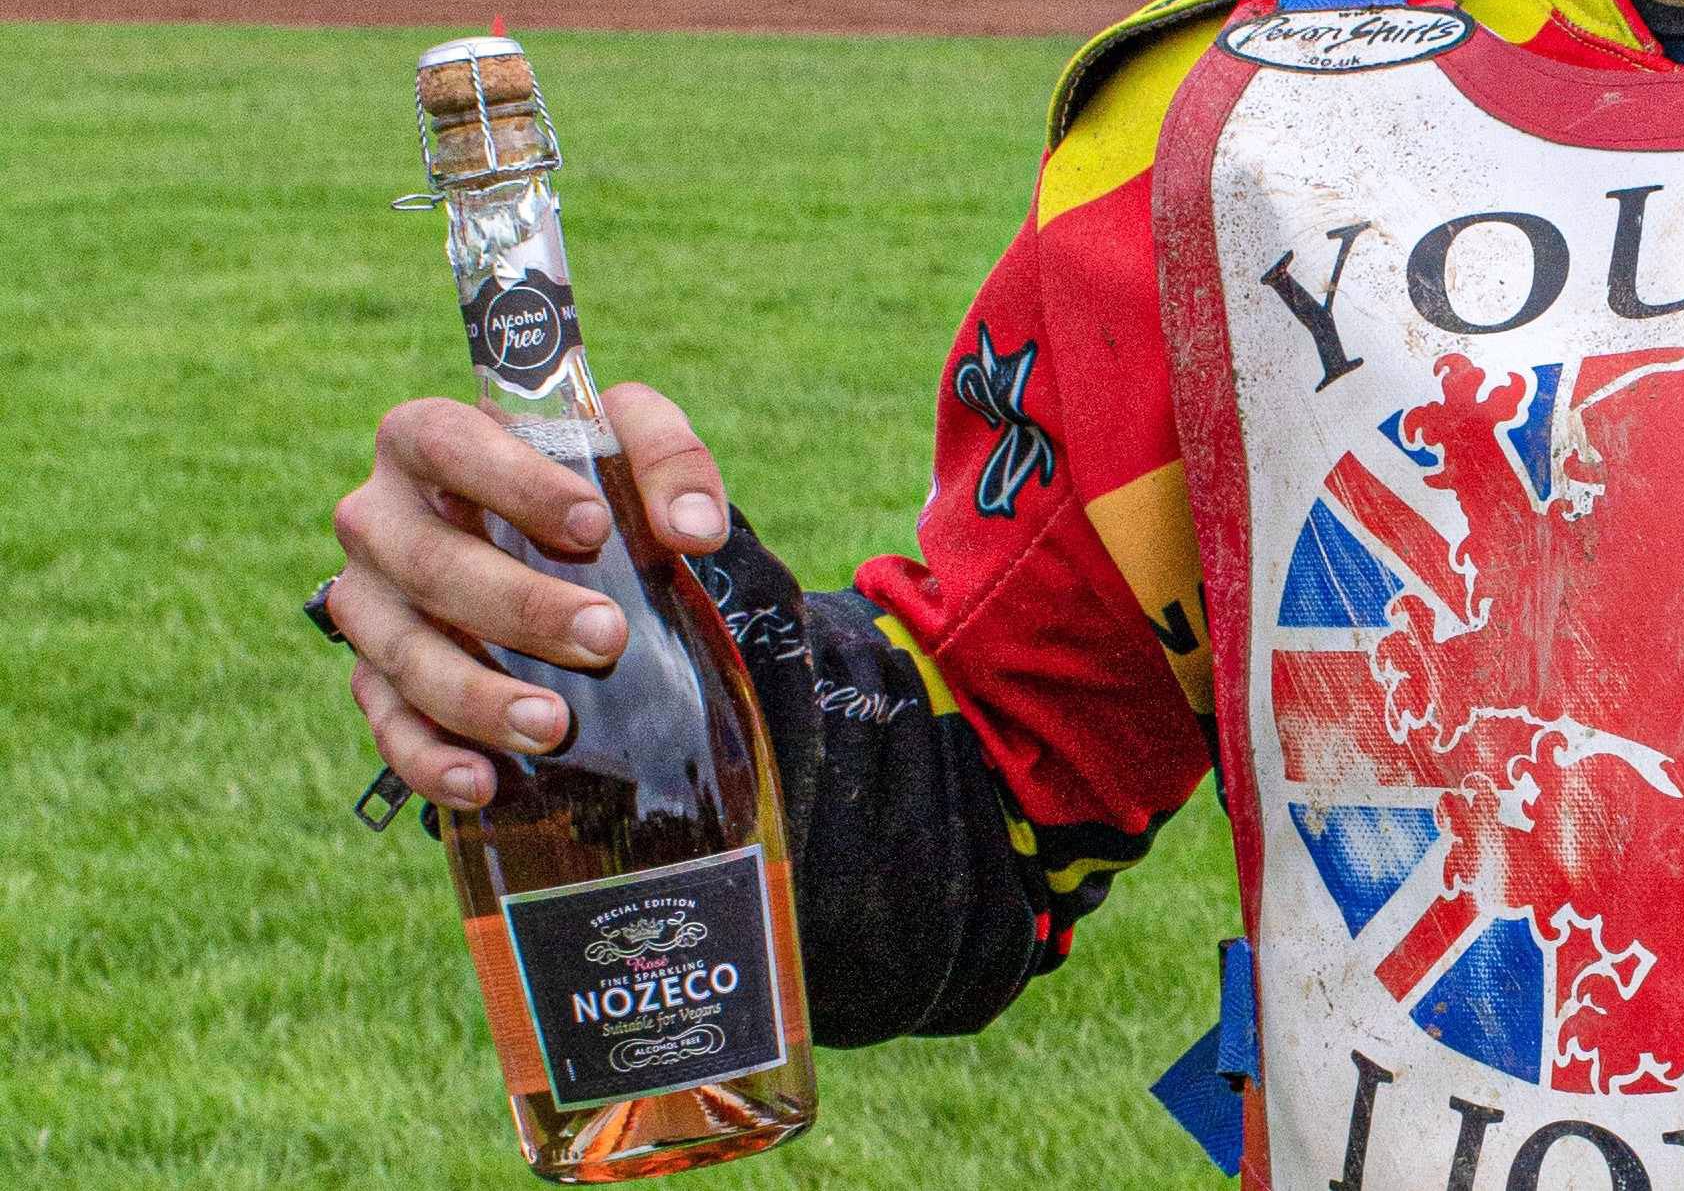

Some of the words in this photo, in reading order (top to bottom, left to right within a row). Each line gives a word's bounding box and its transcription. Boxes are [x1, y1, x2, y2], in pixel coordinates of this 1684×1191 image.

[492, 307, 549, 330] Alcohol
[590, 904, 640, 928] SPECIAL
[644, 898, 696, 909] EDITION
[600, 976, 631, 988] FINE
[634, 960, 704, 982] SPARKLING
[573, 963, 738, 1023] NOZECO
[655, 1012, 676, 1034] for
[680, 1002, 722, 1024] Vegans
[634, 1042, 679, 1056] ALCOHOL
[680, 1036, 702, 1046] FREE
